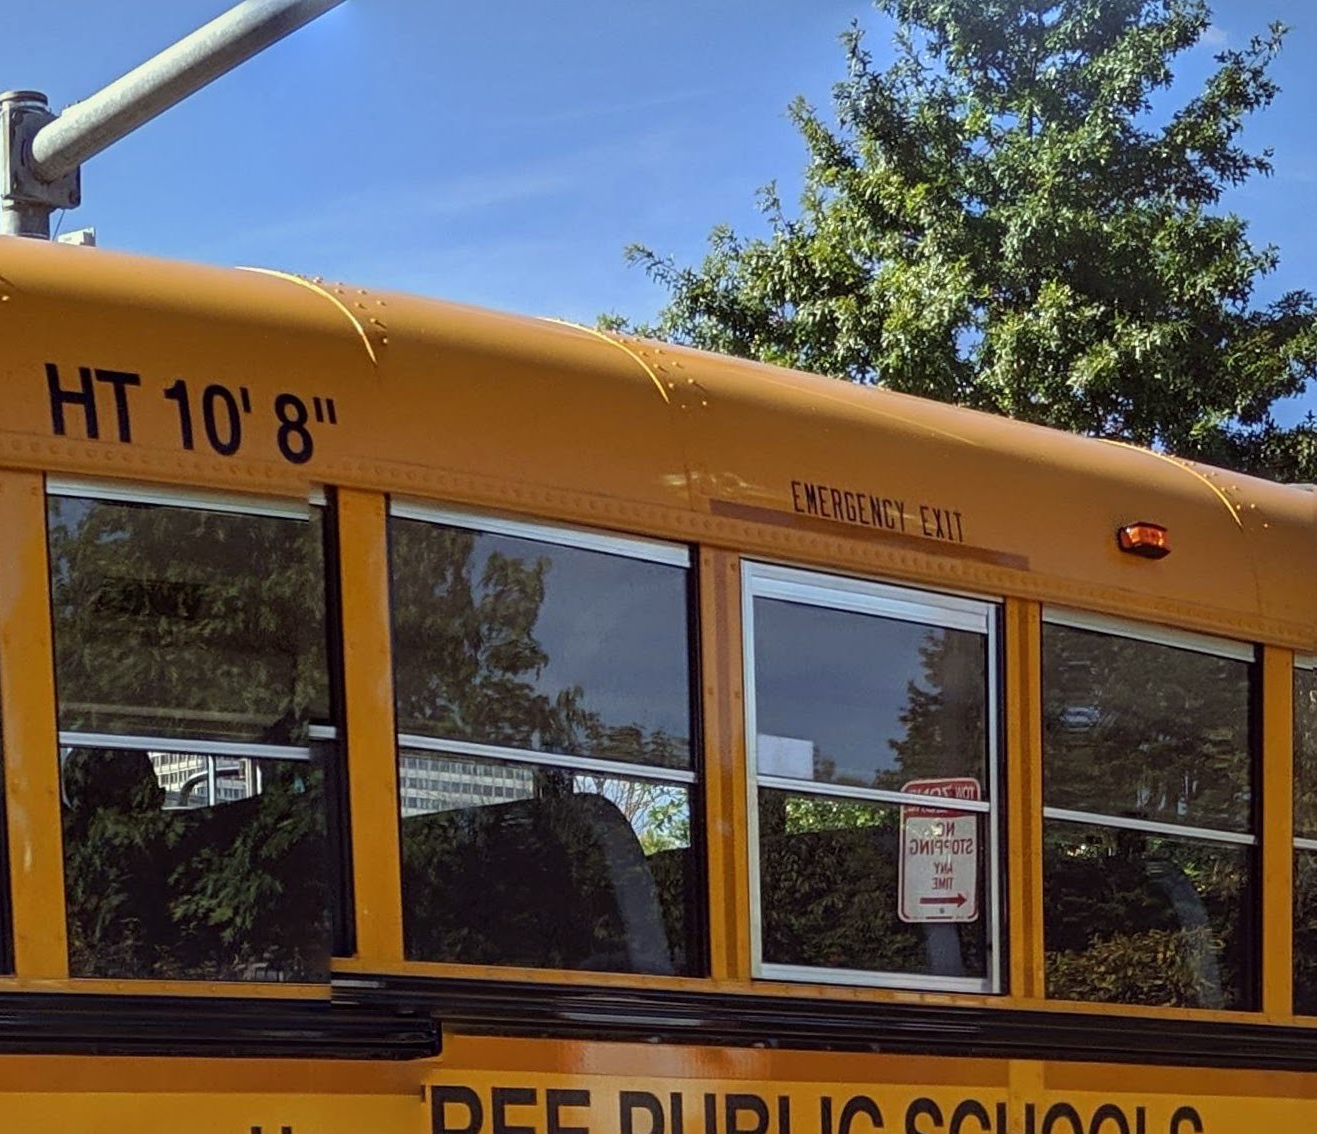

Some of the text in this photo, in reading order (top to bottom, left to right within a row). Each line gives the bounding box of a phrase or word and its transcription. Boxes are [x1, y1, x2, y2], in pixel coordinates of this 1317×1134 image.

[45, 363, 141, 443] HT
[163, 379, 252, 456] 10'
[791, 480, 965, 543] EMERGENCY EXIT
